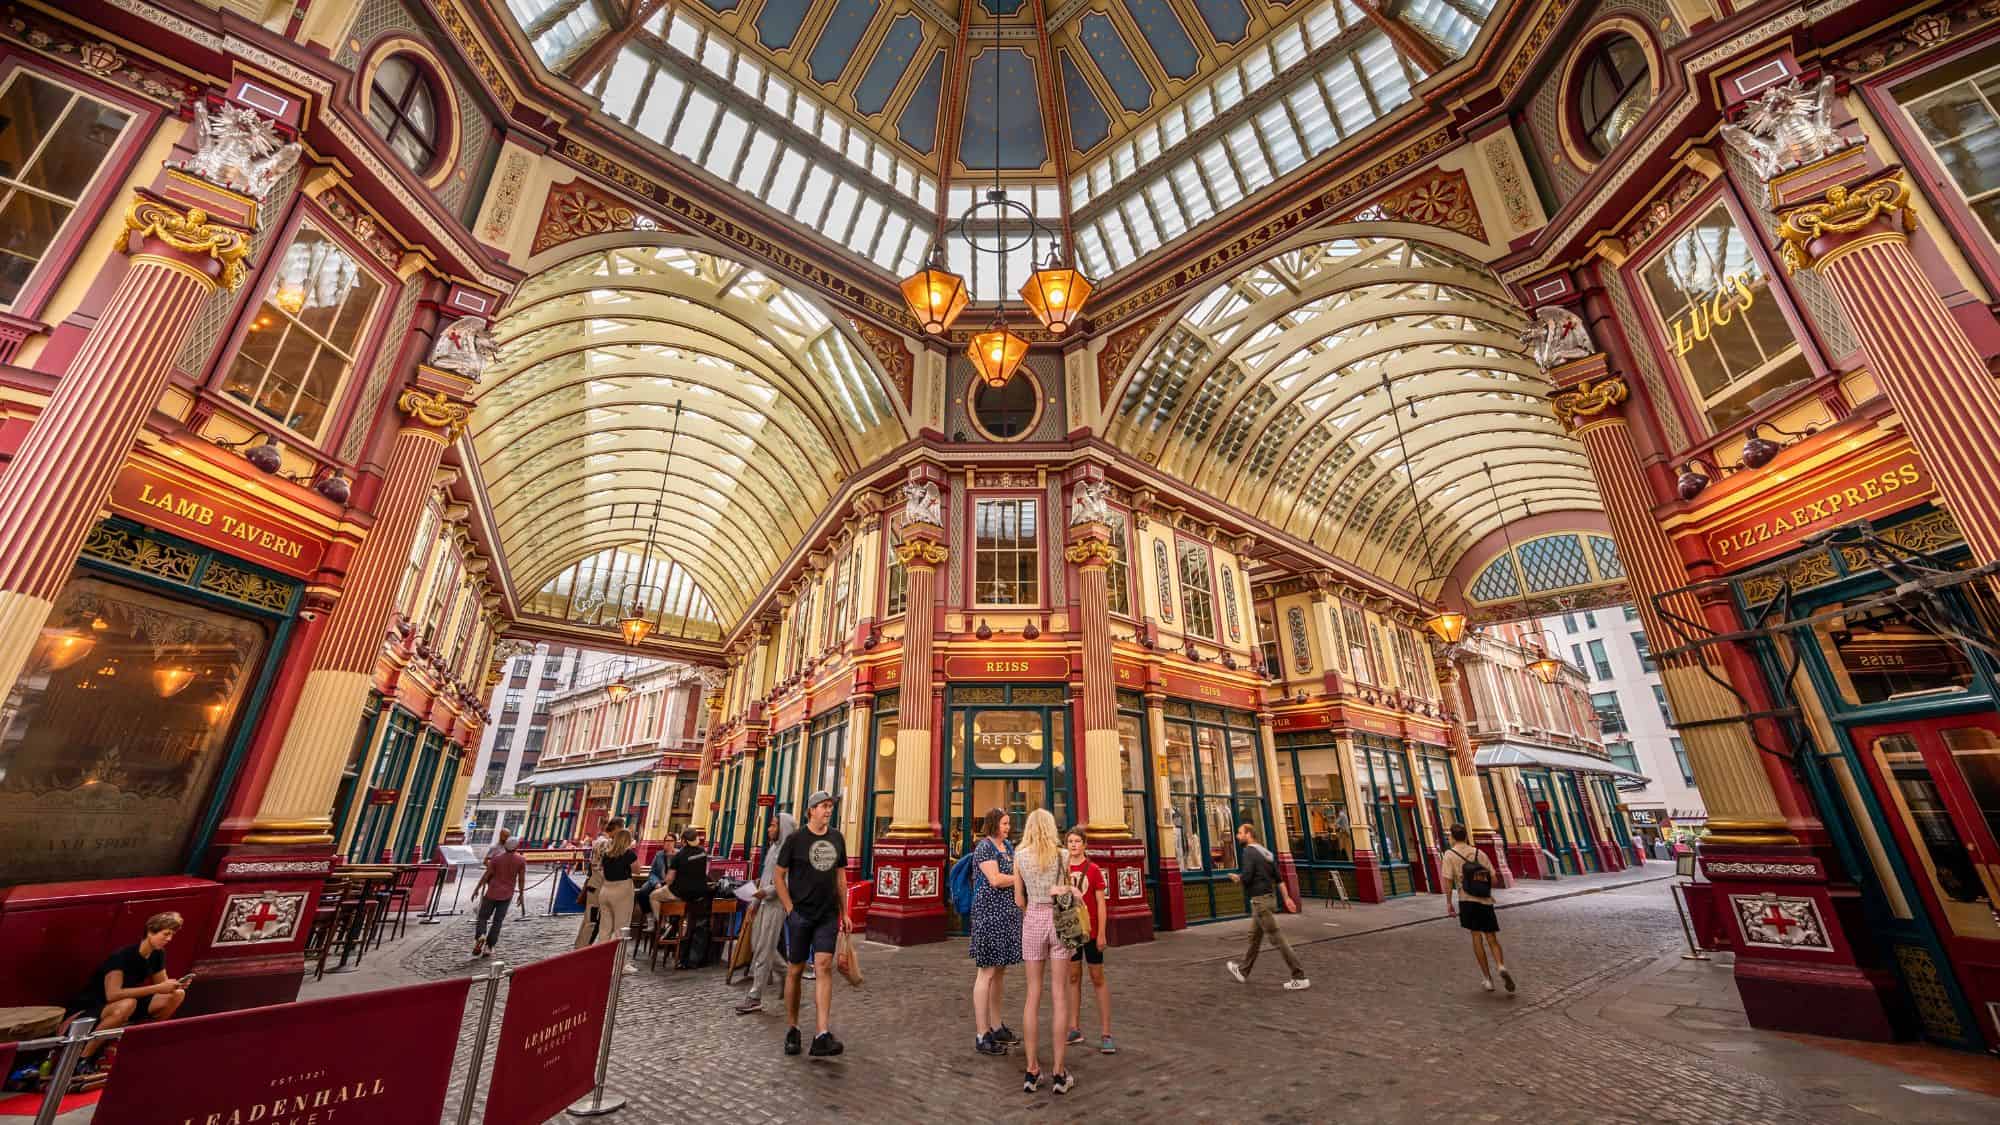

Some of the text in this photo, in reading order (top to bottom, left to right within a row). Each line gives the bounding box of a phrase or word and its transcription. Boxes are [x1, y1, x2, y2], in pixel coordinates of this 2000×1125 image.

[664, 192, 860, 303] LEADENHALL
[1183, 204, 1313, 284] MARKET
[1673, 271, 1753, 357] LUC'S
[138, 484, 303, 559] LAMB TAVERN
[1717, 463, 1919, 556] PIZZAEXPRESS
[986, 661, 1030, 673] REISS
[982, 734, 1032, 745] REISS
